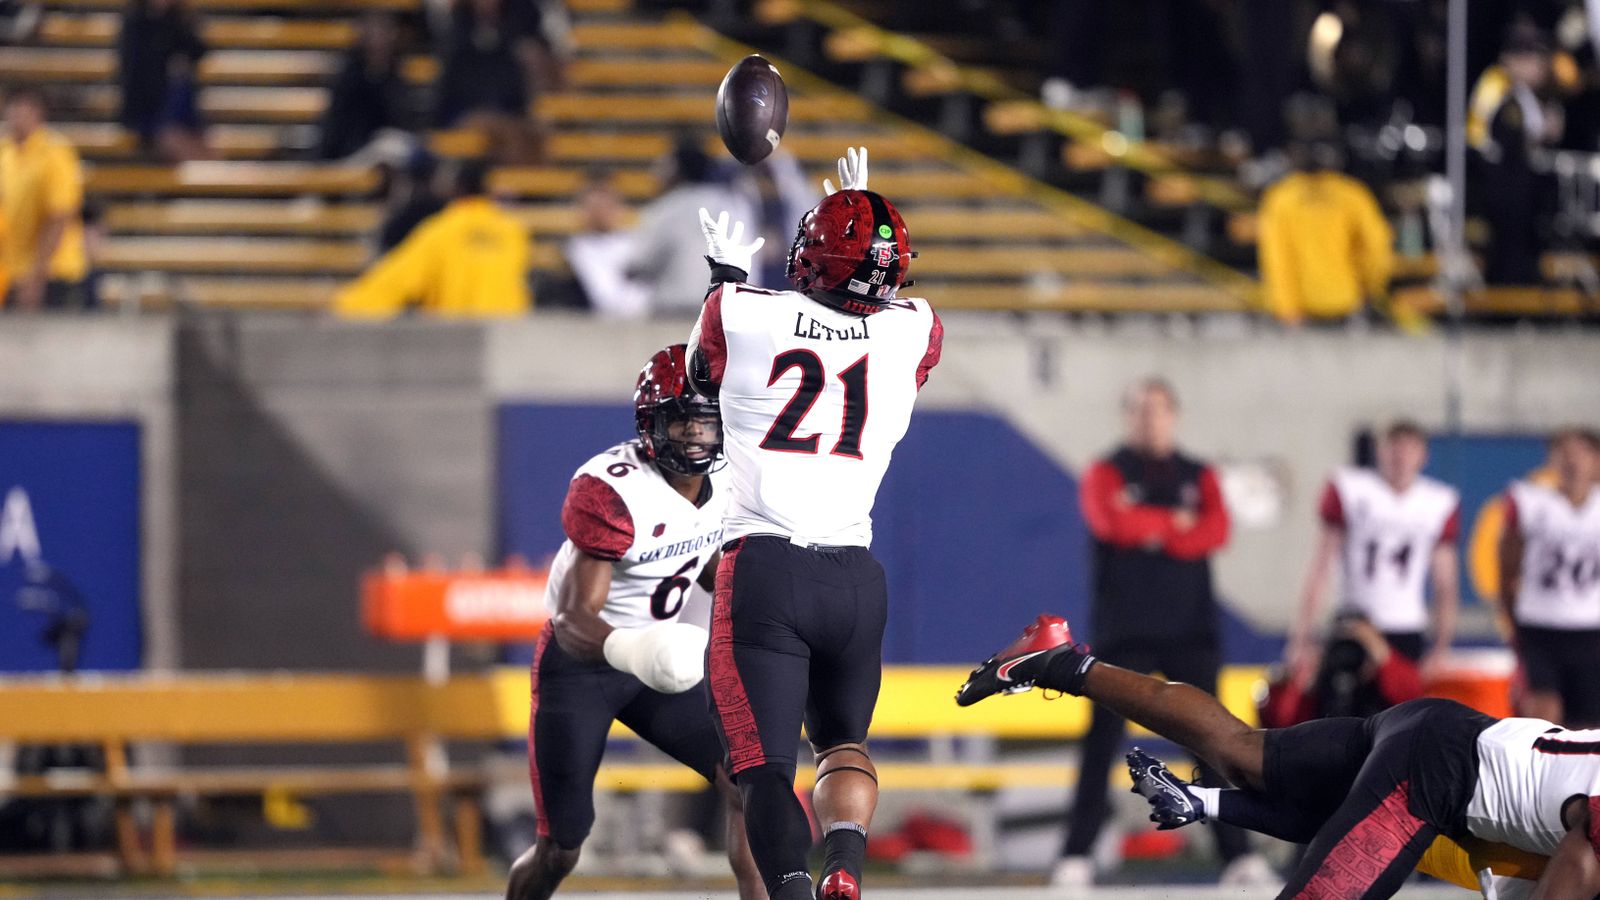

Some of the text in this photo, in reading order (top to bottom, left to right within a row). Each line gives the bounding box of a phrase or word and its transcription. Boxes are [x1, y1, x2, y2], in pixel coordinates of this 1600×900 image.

[868, 269, 886, 286] 21
[794, 311, 870, 341] LETULI
[759, 348, 869, 461] 21
[607, 462, 638, 478] 6
[639, 528, 724, 562] SAN DIEGO STA
[650, 556, 699, 620] 6
